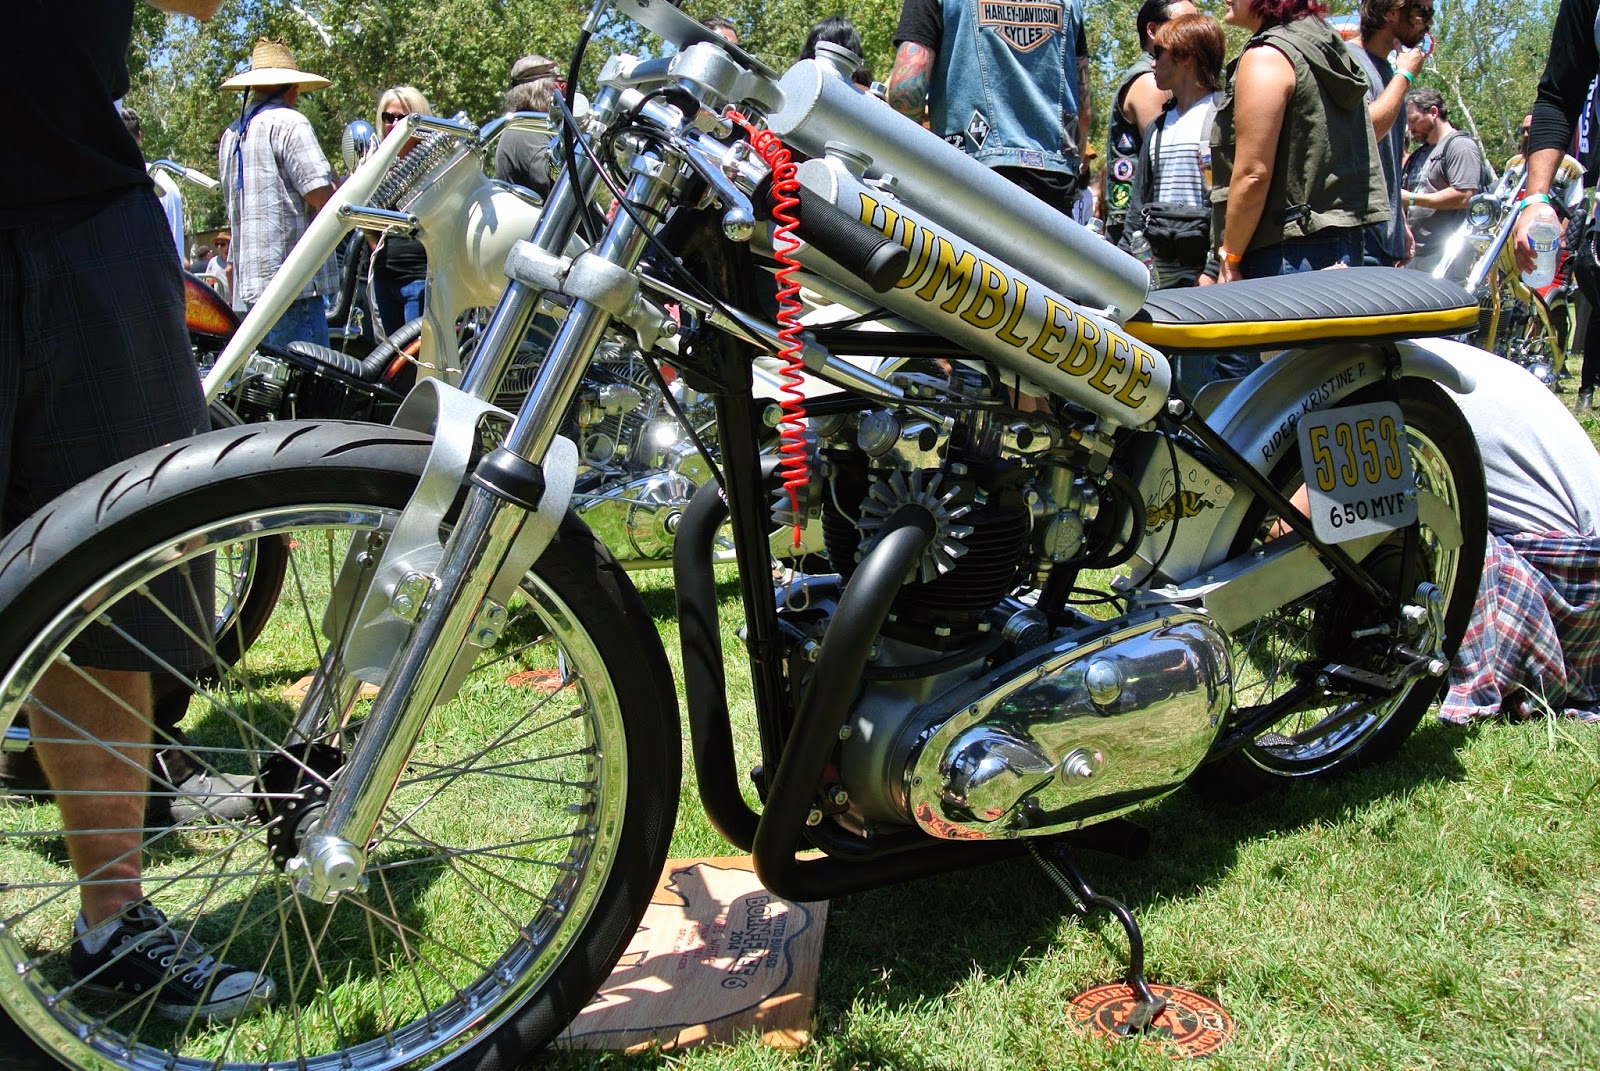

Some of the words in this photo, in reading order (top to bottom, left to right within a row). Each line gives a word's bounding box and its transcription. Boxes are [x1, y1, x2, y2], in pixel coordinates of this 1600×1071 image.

[984, 4, 1059, 25] HARLEY-DAVIDSON
[1004, 25, 1044, 47] CYCLES
[1301, 368, 1355, 415] KRISTINE
[1358, 362, 1367, 378] P.
[1309, 415, 1403, 493] 5353
[727, 930, 741, 950] 2014
[721, 977, 748, 989] 6
